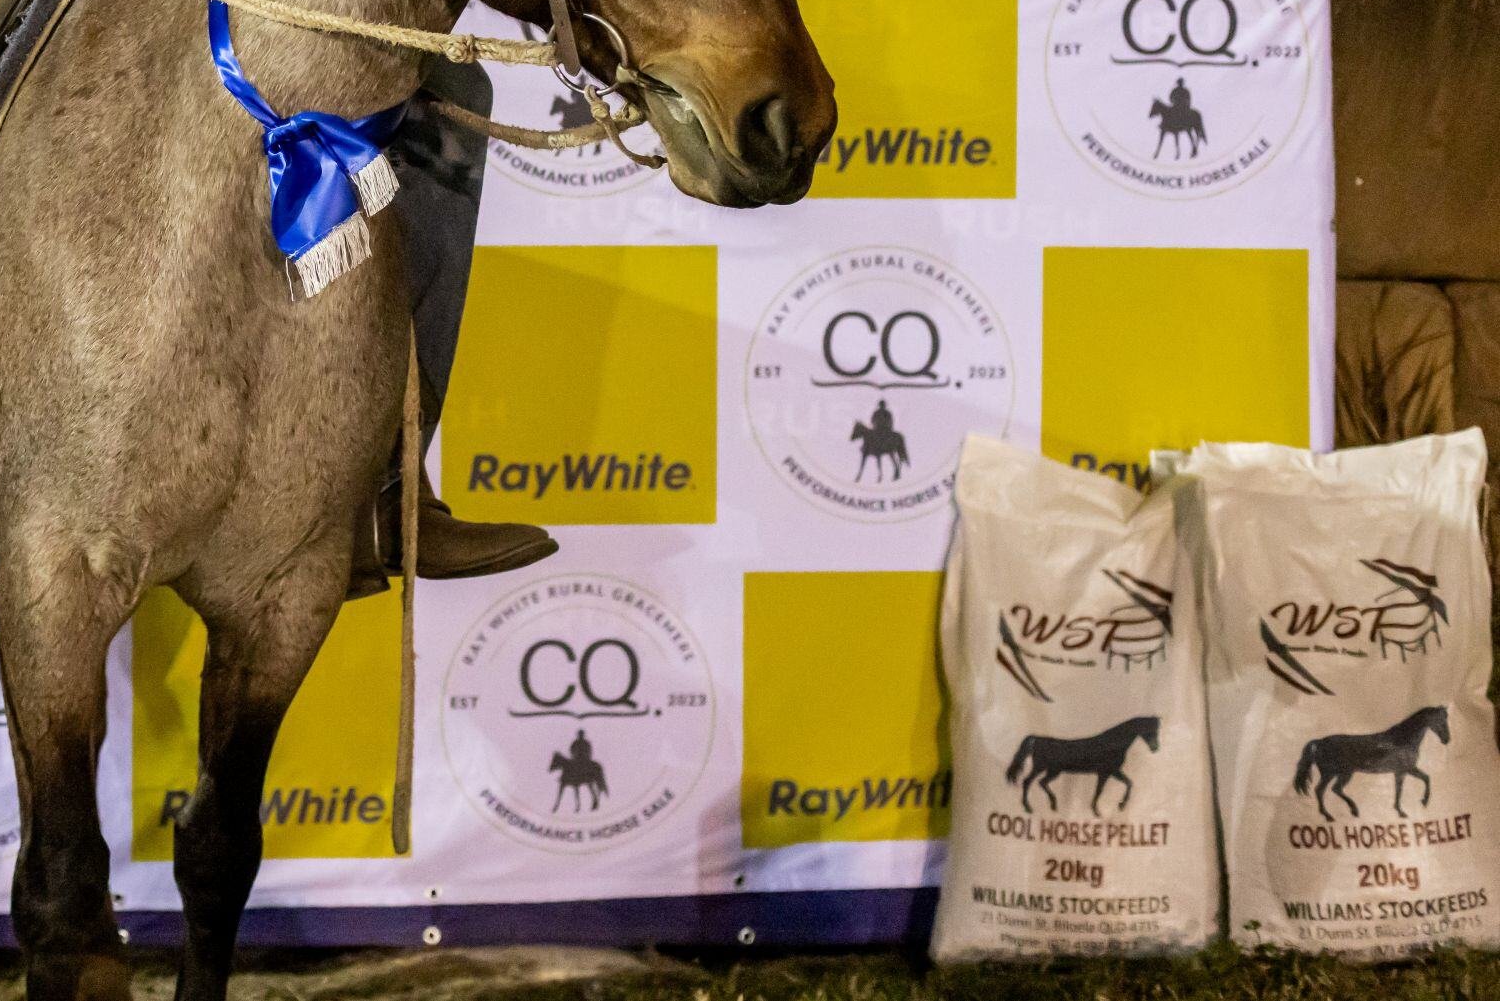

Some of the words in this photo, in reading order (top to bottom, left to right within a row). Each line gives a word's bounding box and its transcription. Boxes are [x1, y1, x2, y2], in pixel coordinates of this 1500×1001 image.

[1053, 43, 1082, 57] EST
[987, 811, 1034, 842] COOL
[1038, 816, 1104, 847] HORSE
[1106, 821, 1171, 847] PELLET
[1289, 822, 1341, 850] COOL
[1346, 820, 1411, 849] HORSE
[1414, 813, 1473, 846] PELLET
[1044, 858, 1104, 888] 20kg
[1357, 863, 1421, 890] 20kg
[972, 886, 1054, 914] WILLIAMS
[1058, 895, 1171, 915] STOCKFEEDS
[1283, 902, 1374, 921] WILLIAMS
[1378, 887, 1488, 920] STOCKFEEDS
